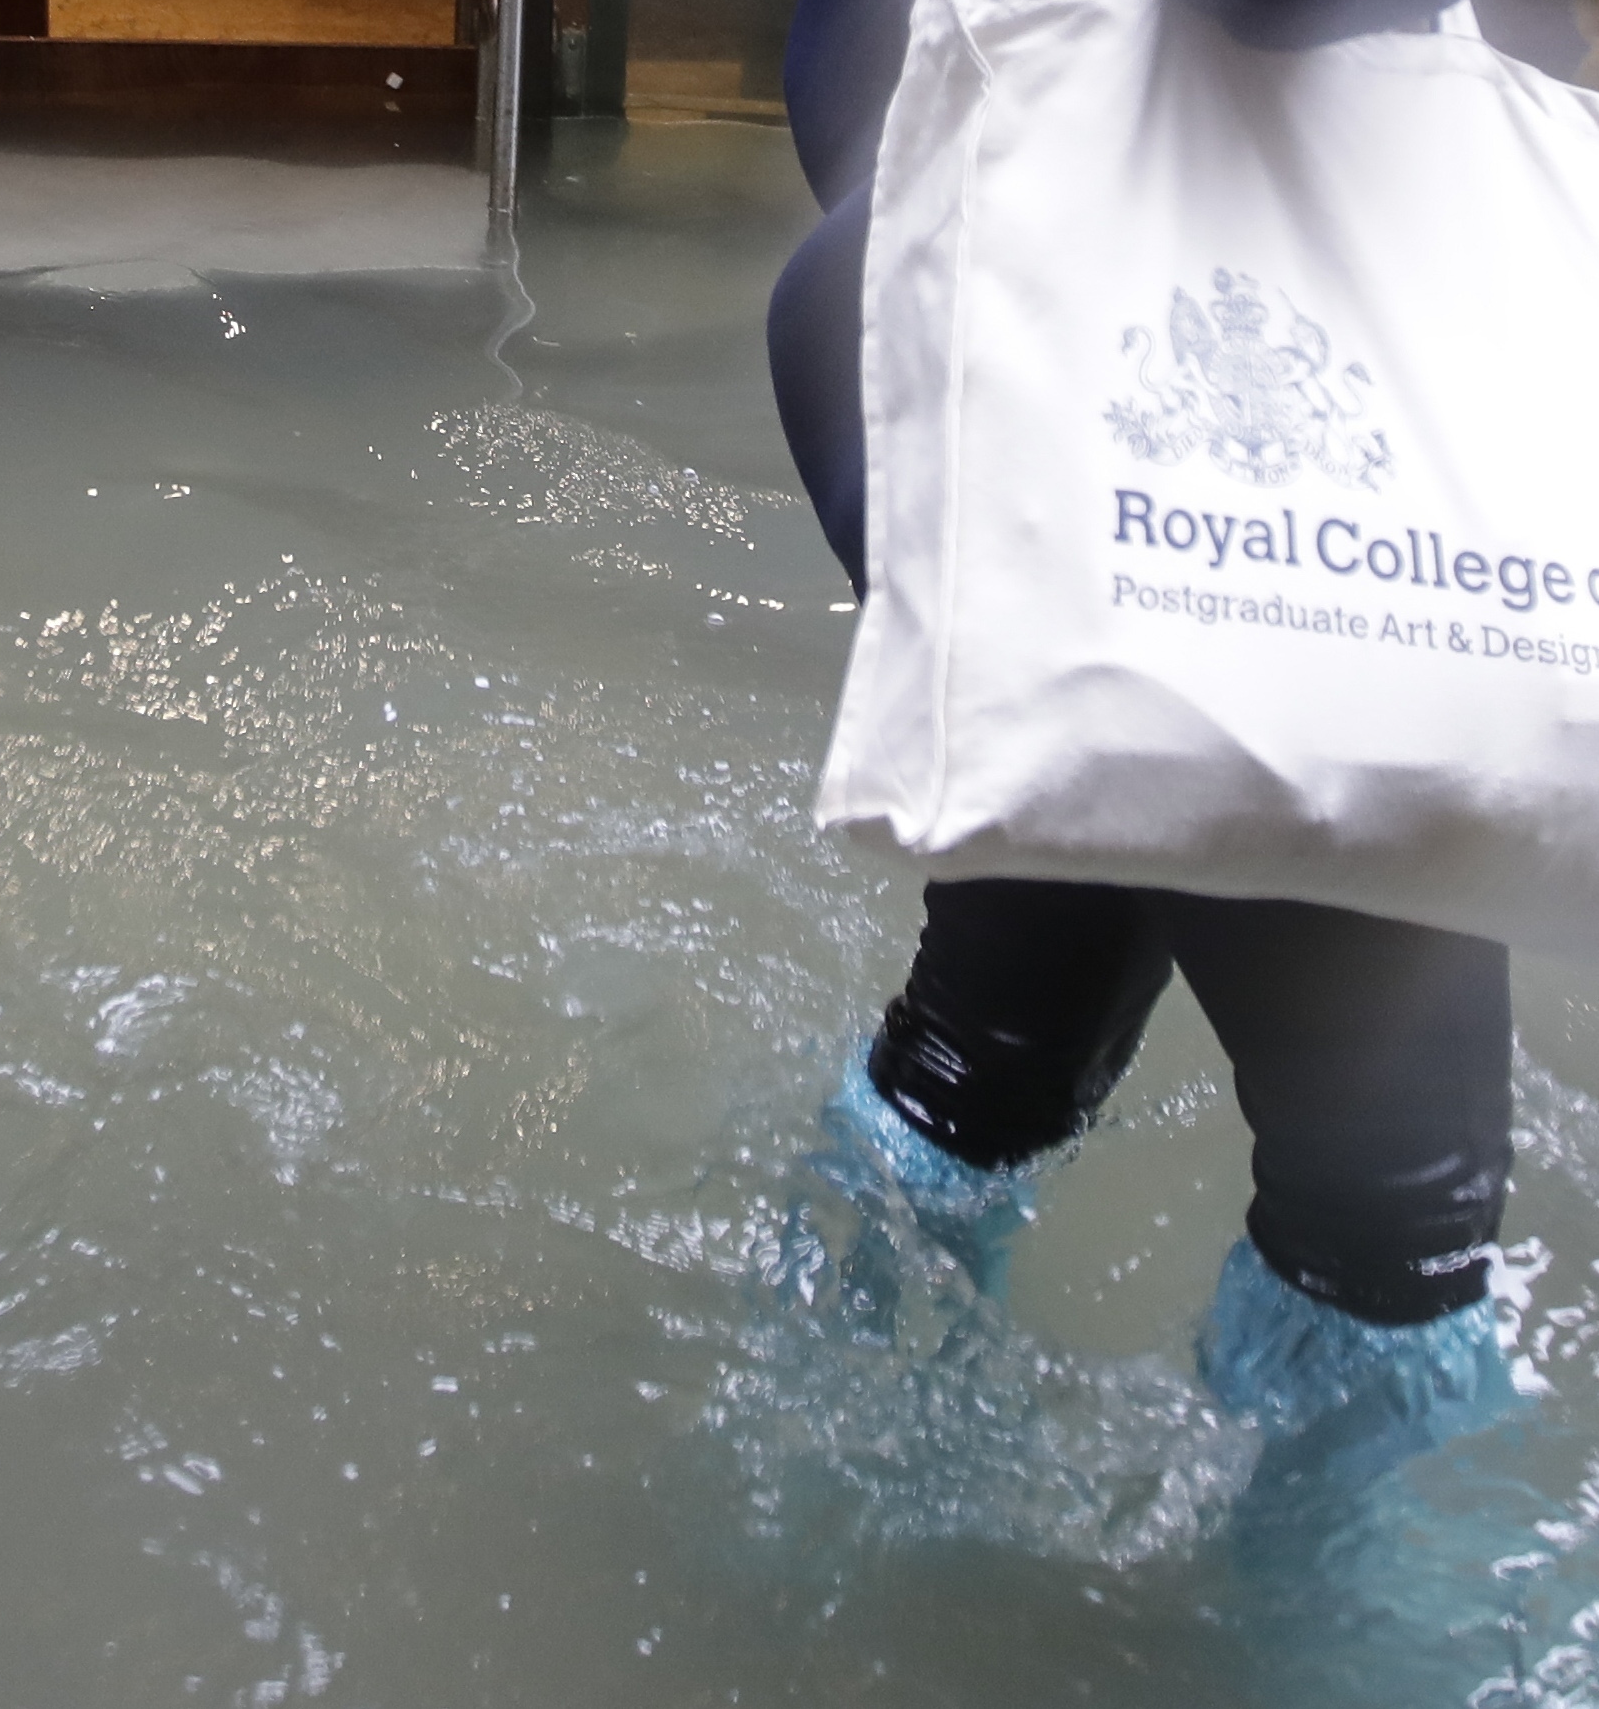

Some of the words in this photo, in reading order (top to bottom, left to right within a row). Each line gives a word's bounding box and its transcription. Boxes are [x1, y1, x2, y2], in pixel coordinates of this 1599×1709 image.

[1114, 489, 1302, 569] Royal
[1316, 518, 1576, 613] College
[1112, 574, 1369, 639] Postgraduate
[1378, 612, 1439, 650] Art
[1448, 621, 1474, 655] &
